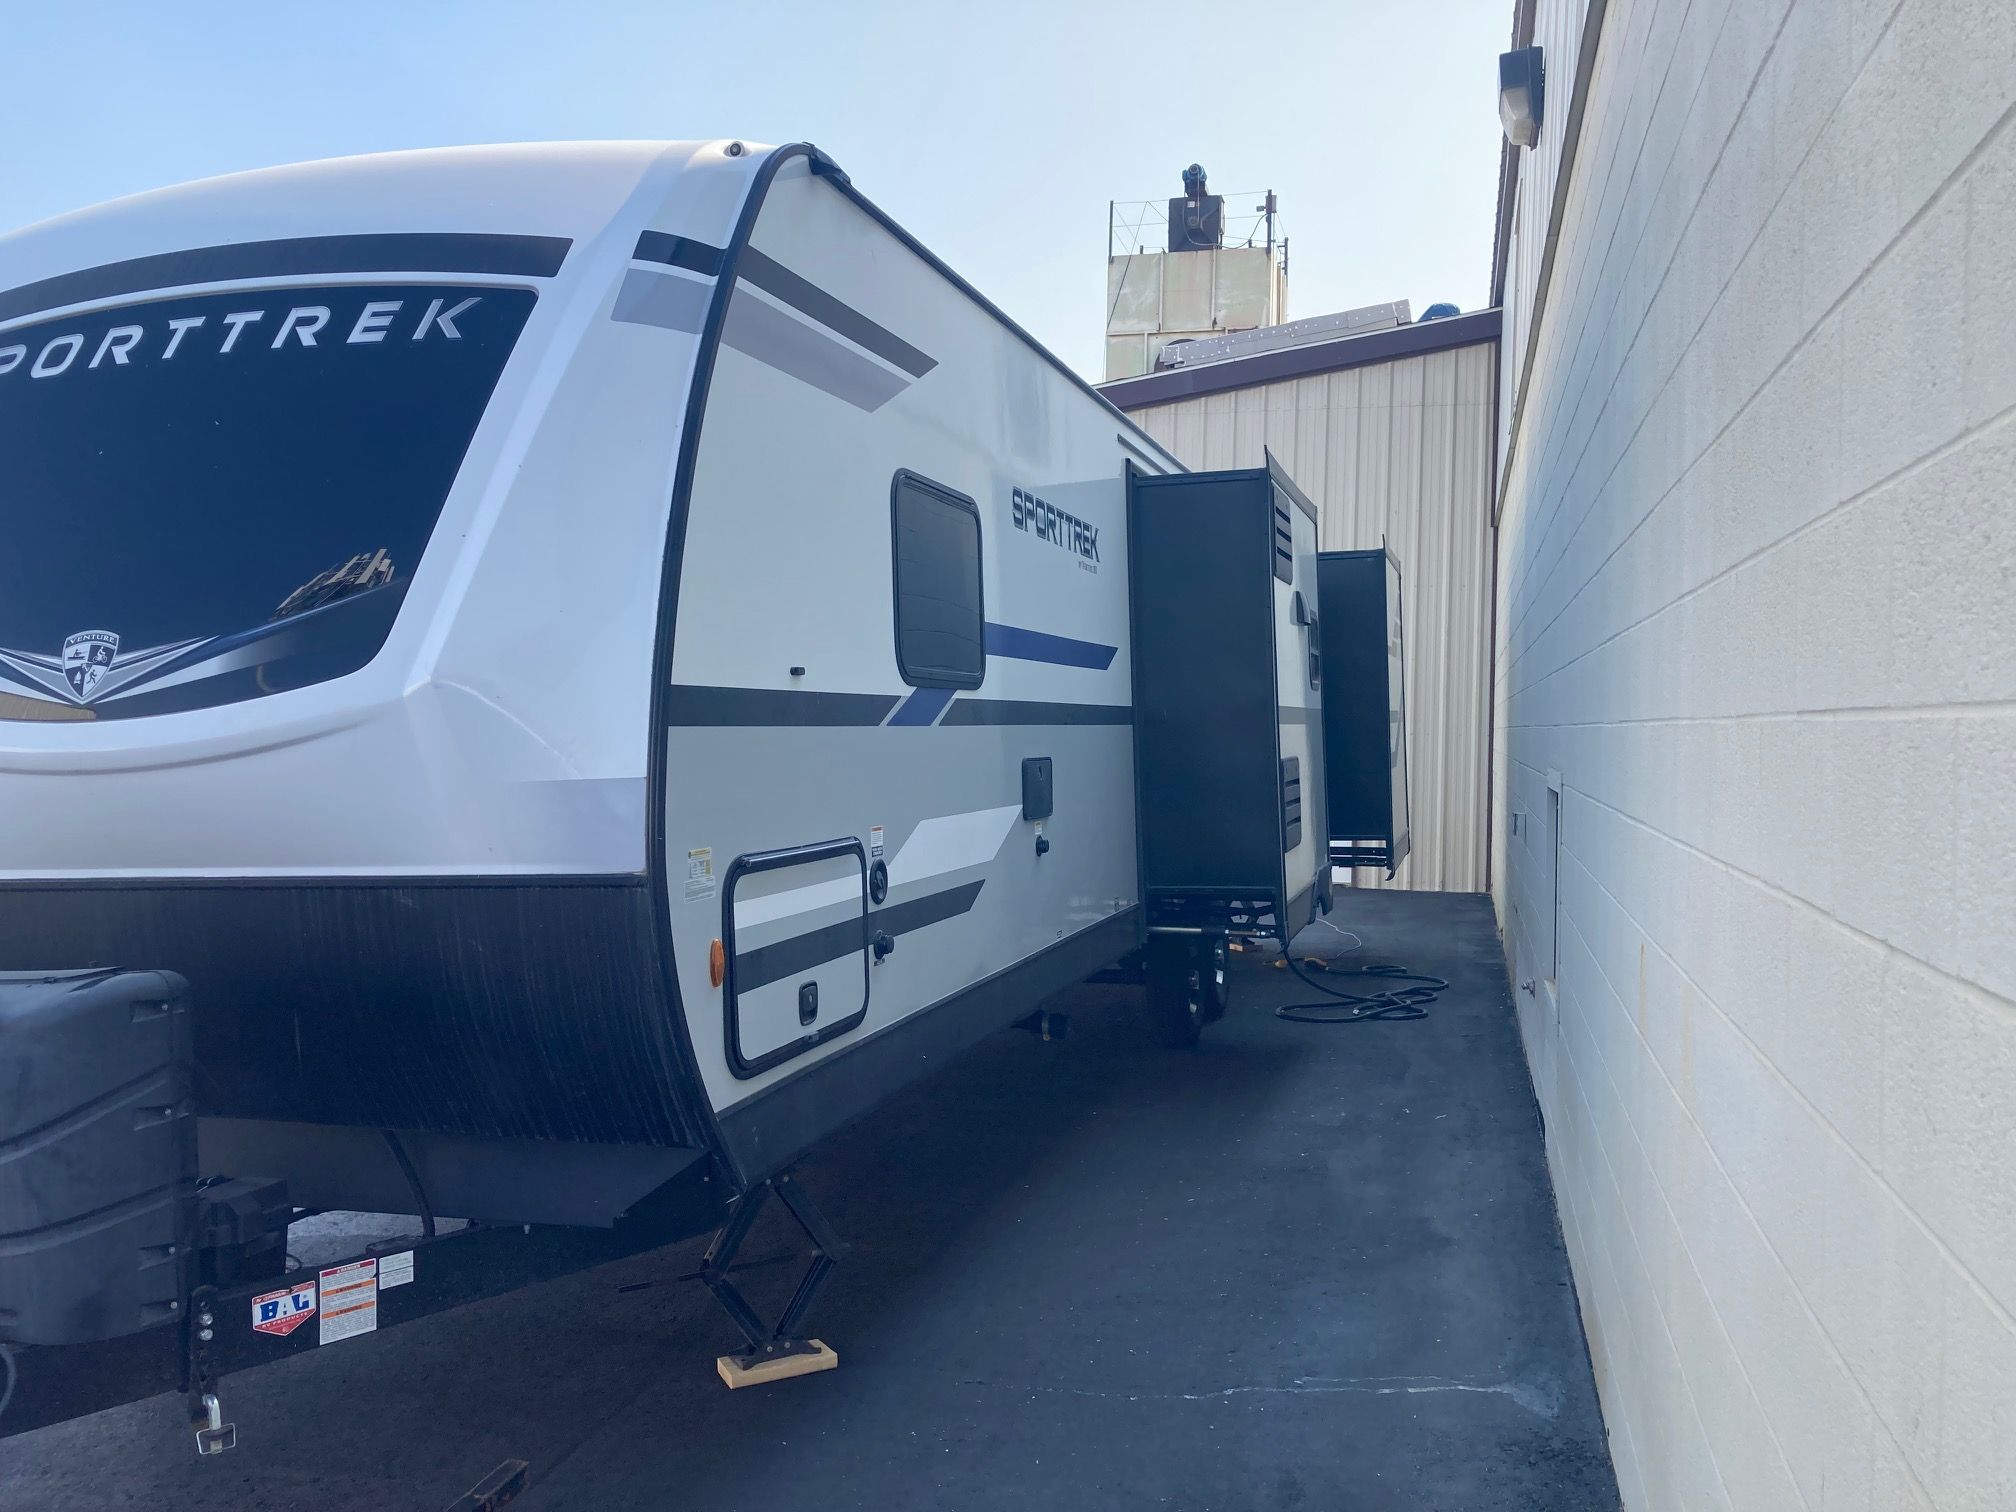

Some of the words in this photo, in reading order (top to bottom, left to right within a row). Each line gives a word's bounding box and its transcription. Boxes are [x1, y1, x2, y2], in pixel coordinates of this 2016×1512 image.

[1012, 485, 1100, 563] SPORTTREK
[69, 634, 115, 644] VENTURE
[260, 1294, 310, 1322] BAL
